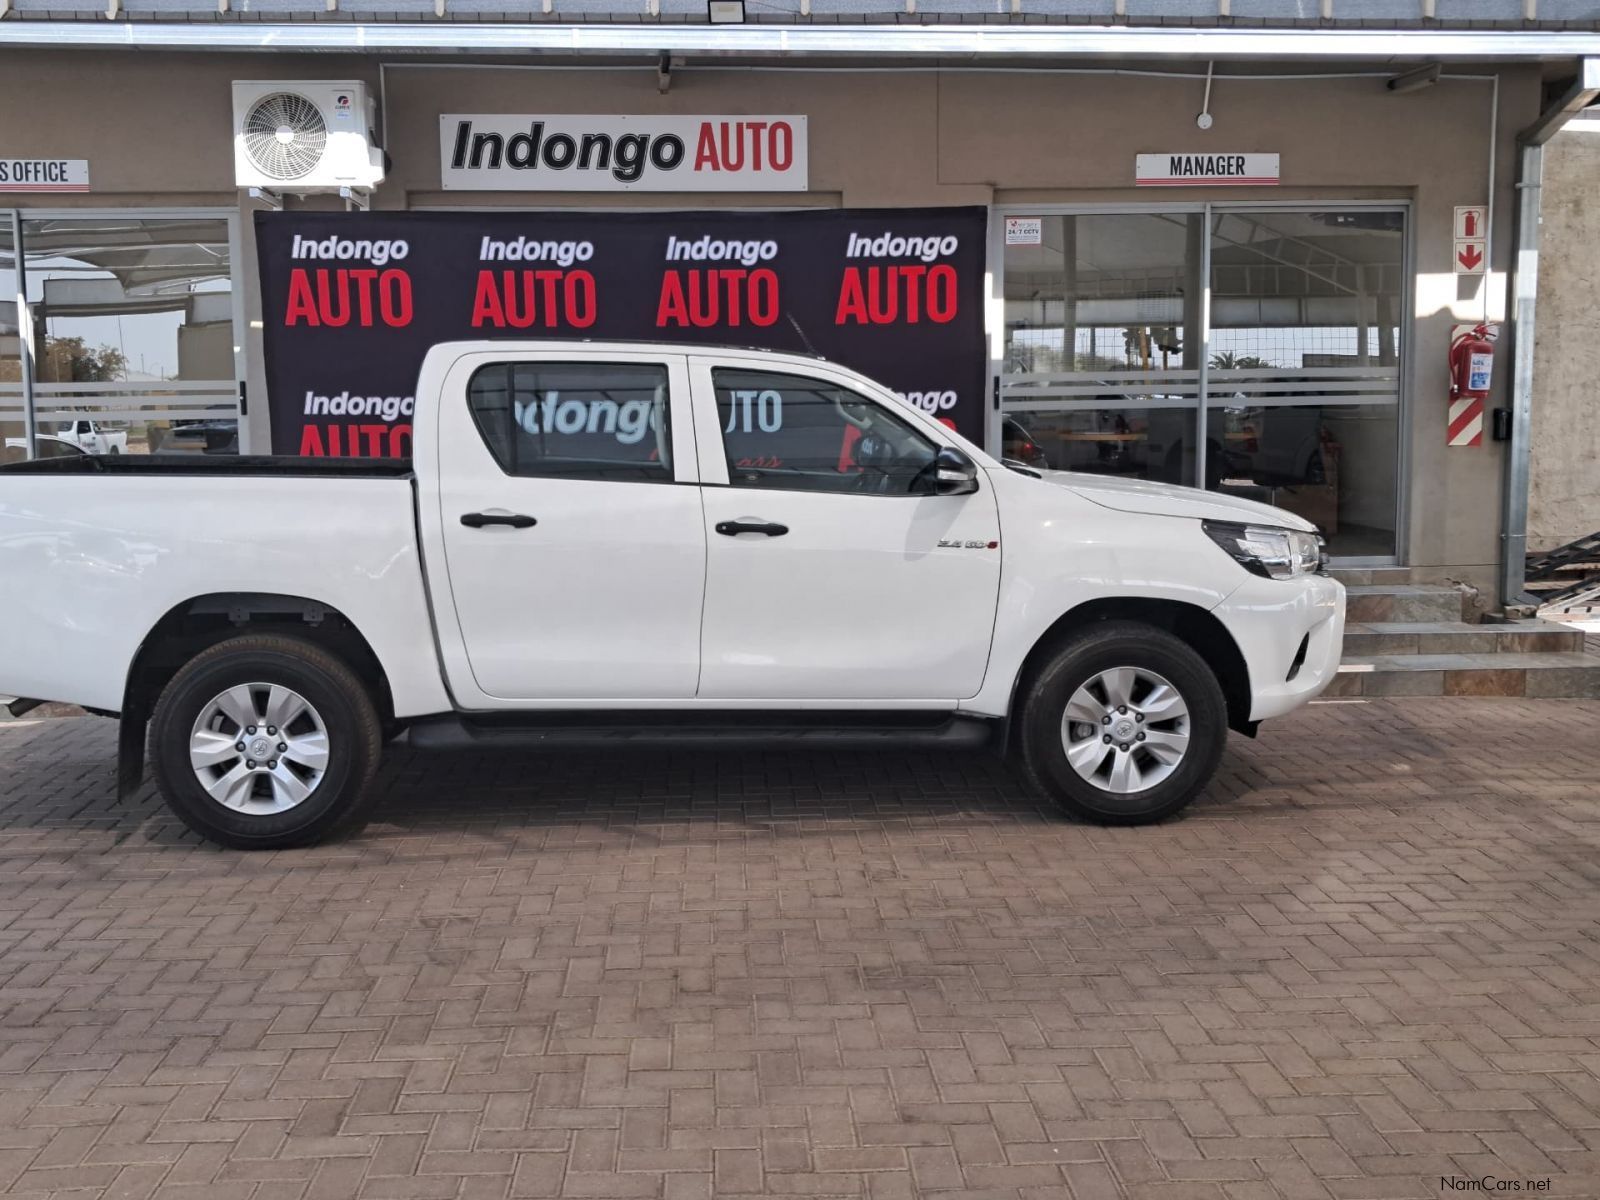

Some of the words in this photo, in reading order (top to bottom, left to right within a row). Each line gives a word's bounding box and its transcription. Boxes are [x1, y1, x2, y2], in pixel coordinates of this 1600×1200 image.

[450, 120, 685, 183] Indongo
[694, 121, 793, 172] AUTO
[1169, 155, 1245, 177] MANAGER
[12, 161, 69, 182] OFFICE
[291, 234, 409, 266] Indongo
[479, 235, 594, 268] Indongo
[665, 235, 778, 267] Indongo
[846, 231, 959, 263] Indongo
[284, 268, 414, 328] AUTO
[470, 268, 598, 329] AUTO
[655, 268, 781, 328] AUTO
[834, 263, 959, 326] AUTO
